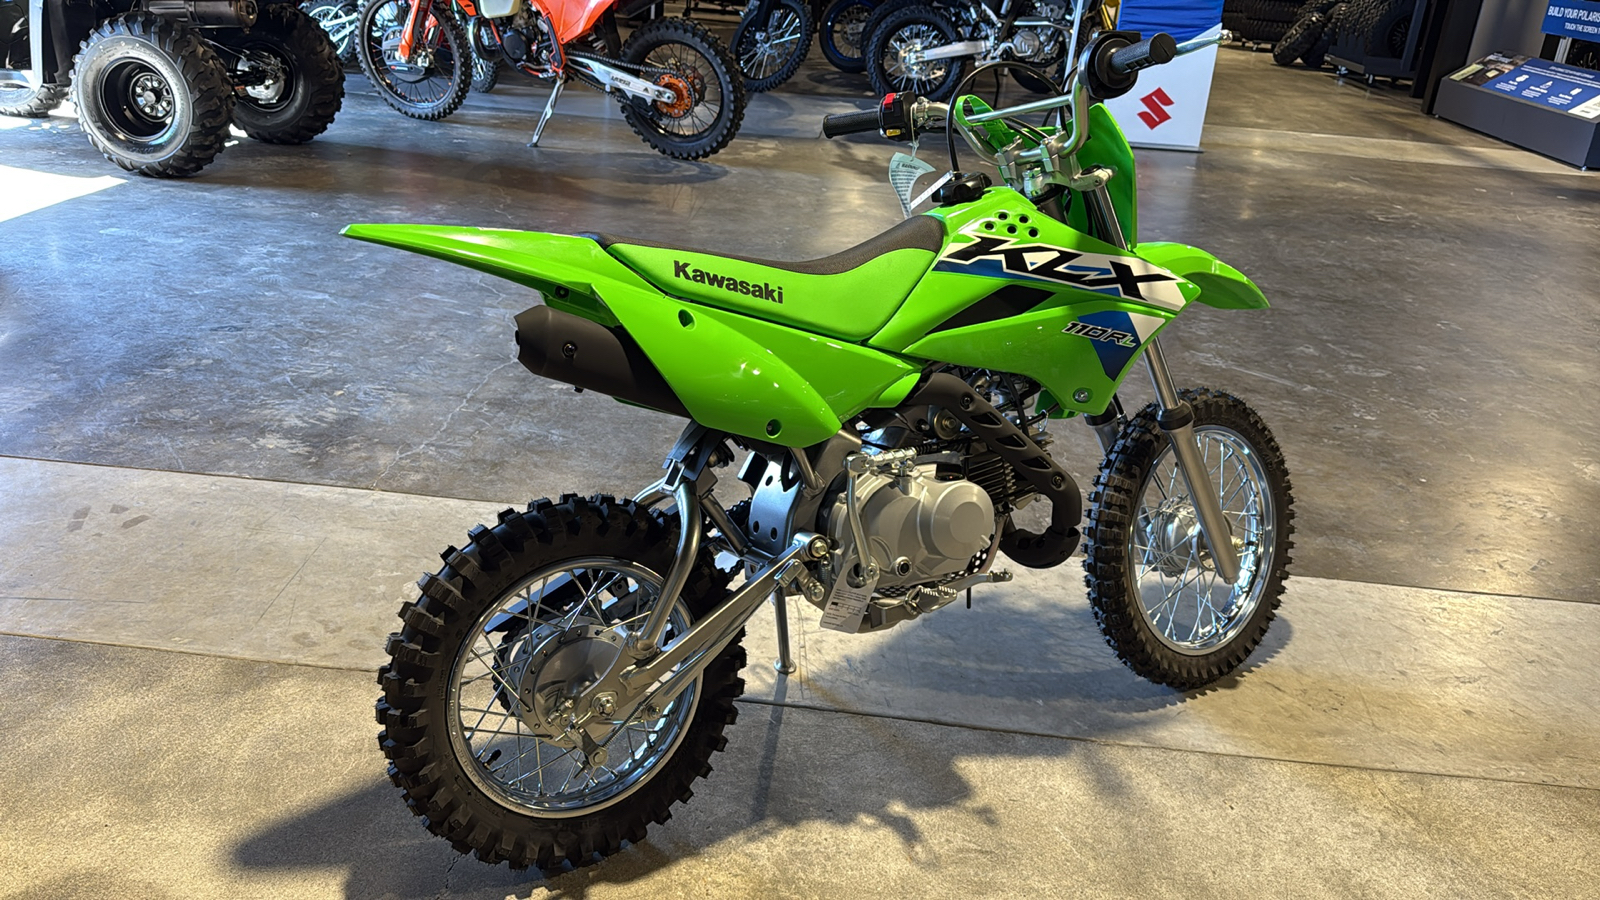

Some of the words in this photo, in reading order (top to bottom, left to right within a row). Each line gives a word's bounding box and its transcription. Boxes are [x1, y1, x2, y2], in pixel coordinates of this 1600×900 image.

[1548, 5, 1564, 17] BUILD
[1564, 7, 1579, 19] YOUR
[1578, 9, 1600, 22] POLARIS
[1564, 22, 1576, 30] TOUCH
[1576, 24, 1584, 32] THE
[1583, 25, 1598, 34] SCREEN
[673, 260, 784, 304] Kawasaki
[944, 233, 1178, 302] KLX
